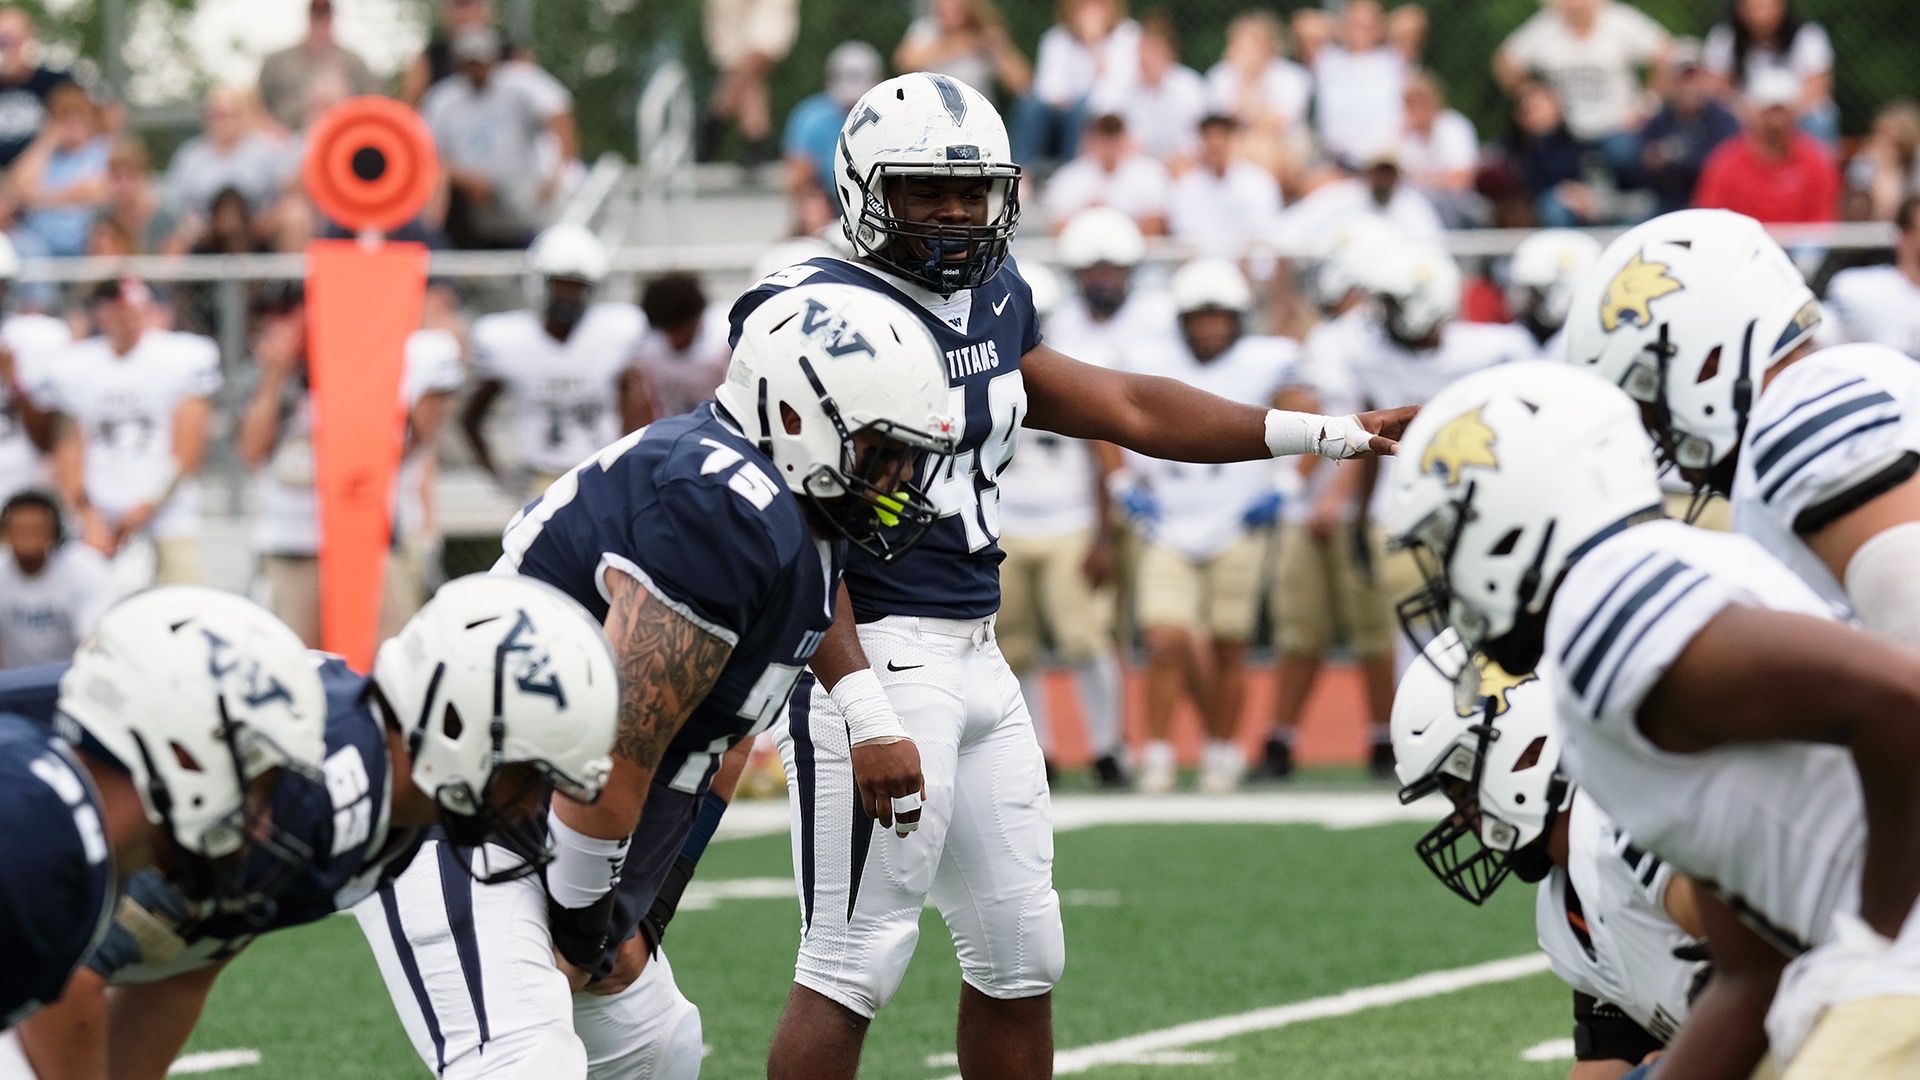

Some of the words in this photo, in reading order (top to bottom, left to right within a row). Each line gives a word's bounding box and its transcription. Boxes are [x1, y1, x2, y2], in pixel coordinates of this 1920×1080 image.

[946, 339, 1000, 380] TITANS
[700, 438, 781, 512] 75
[920, 369, 1028, 554] 49
